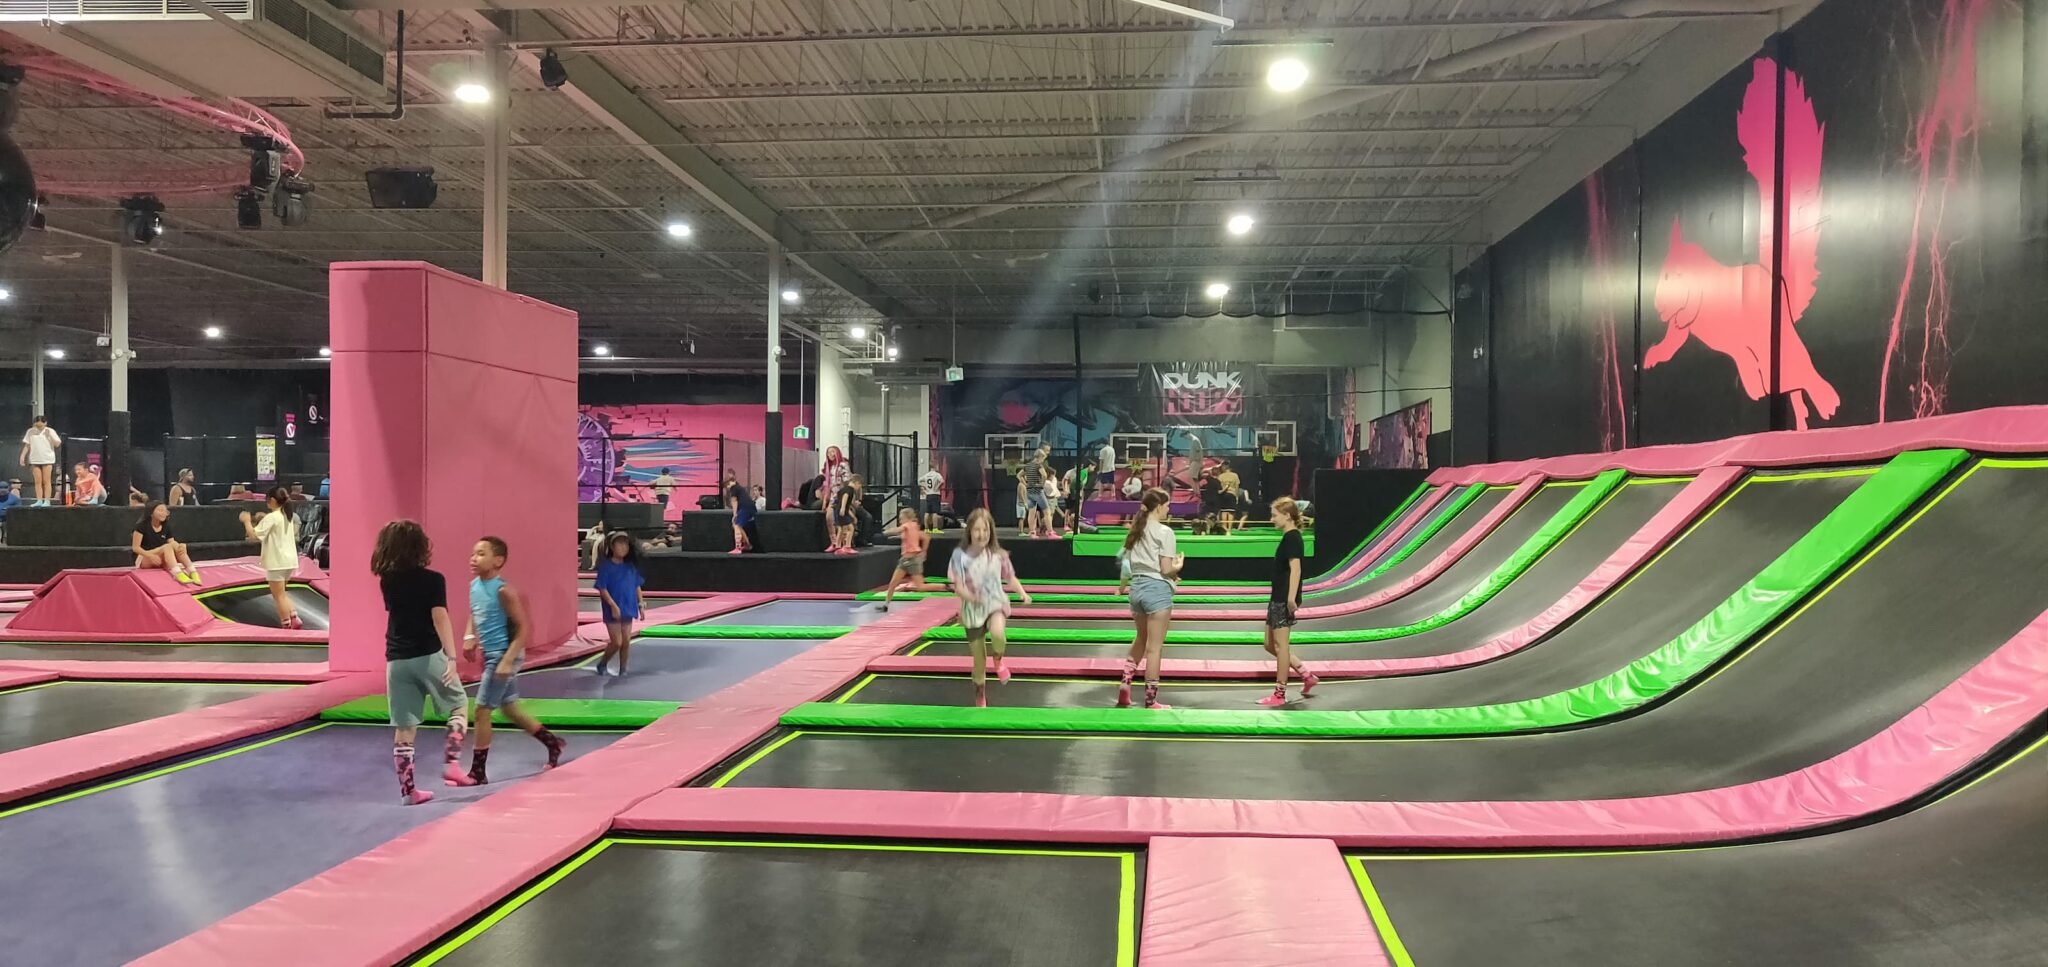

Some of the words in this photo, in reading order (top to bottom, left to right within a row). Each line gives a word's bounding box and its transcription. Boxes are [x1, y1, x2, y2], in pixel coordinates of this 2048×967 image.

[1162, 371, 1242, 389] DUNK
[1163, 389, 1243, 415] HOOPS
[926, 478, 933, 489] 9
